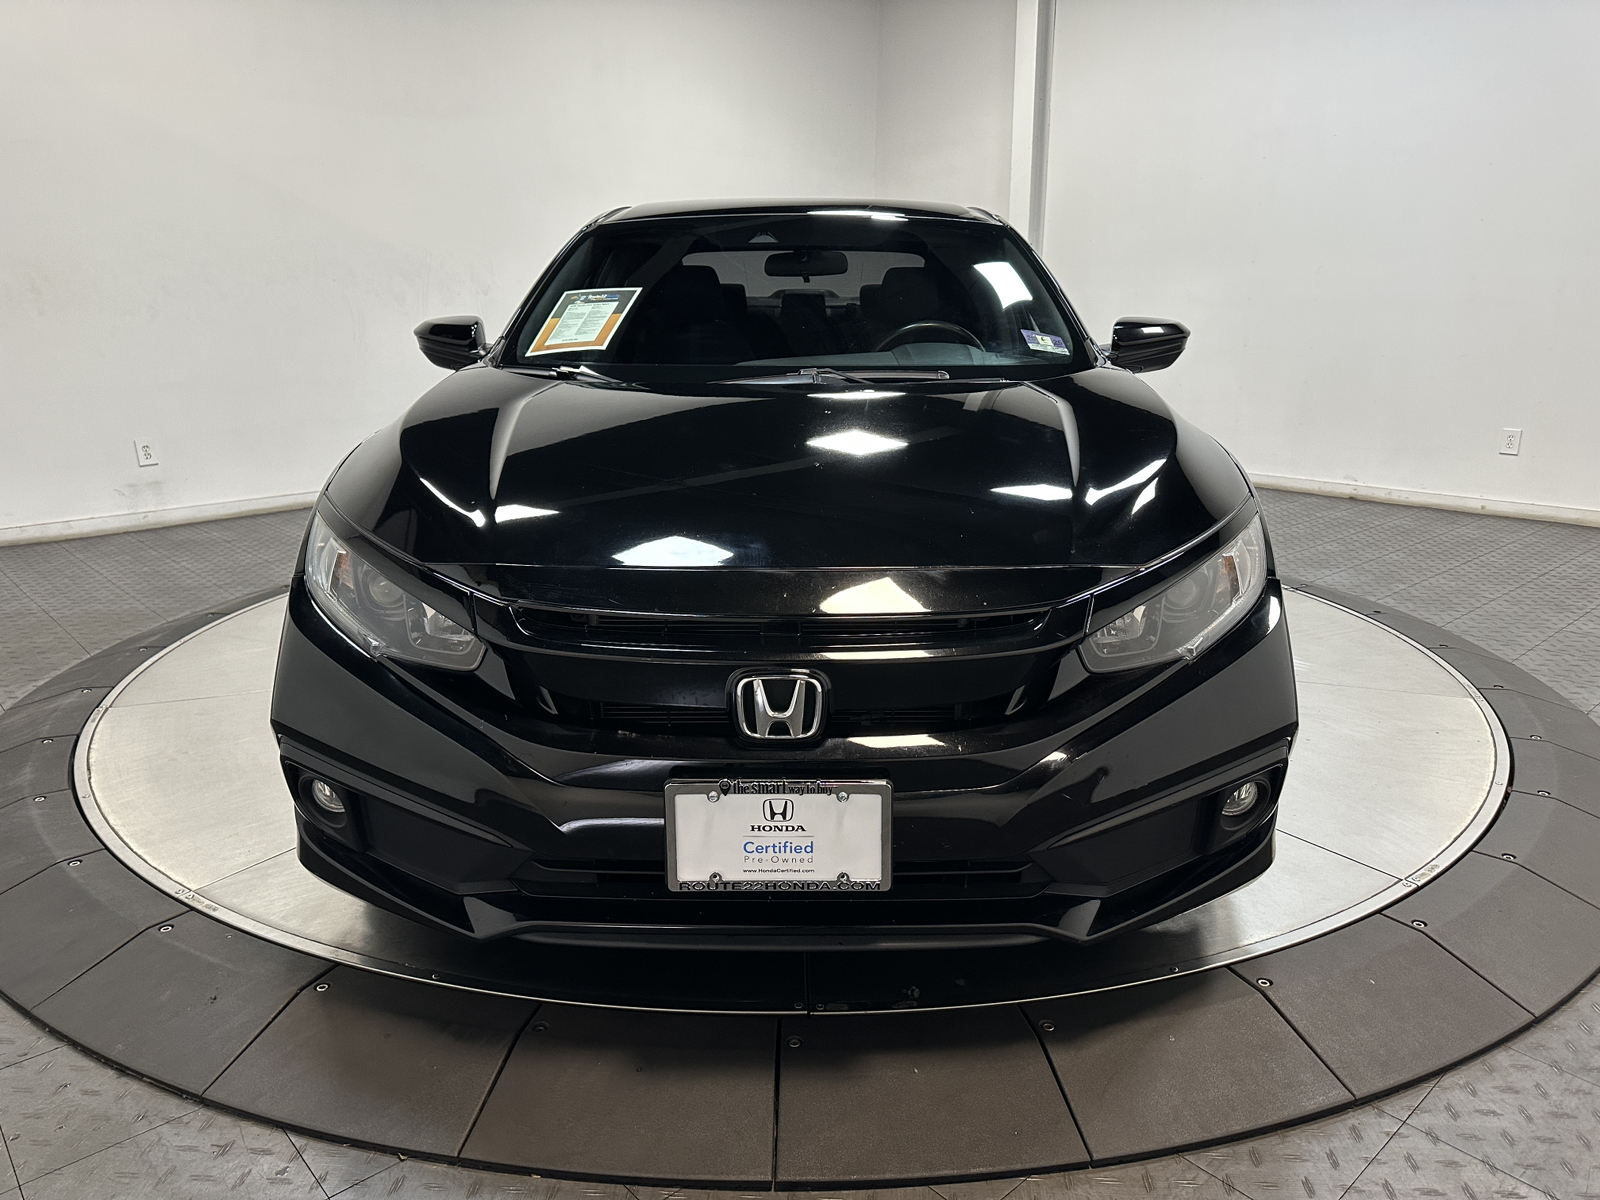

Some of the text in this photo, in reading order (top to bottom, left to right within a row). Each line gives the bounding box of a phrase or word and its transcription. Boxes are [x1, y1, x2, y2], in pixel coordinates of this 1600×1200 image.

[733, 779, 833, 796] the smart way to buy
[750, 824, 807, 832] HONDA
[743, 841, 814, 854] Certified
[744, 855, 814, 864] Pre-Owned
[679, 881, 881, 891] ROUTE22HONDA.COM
